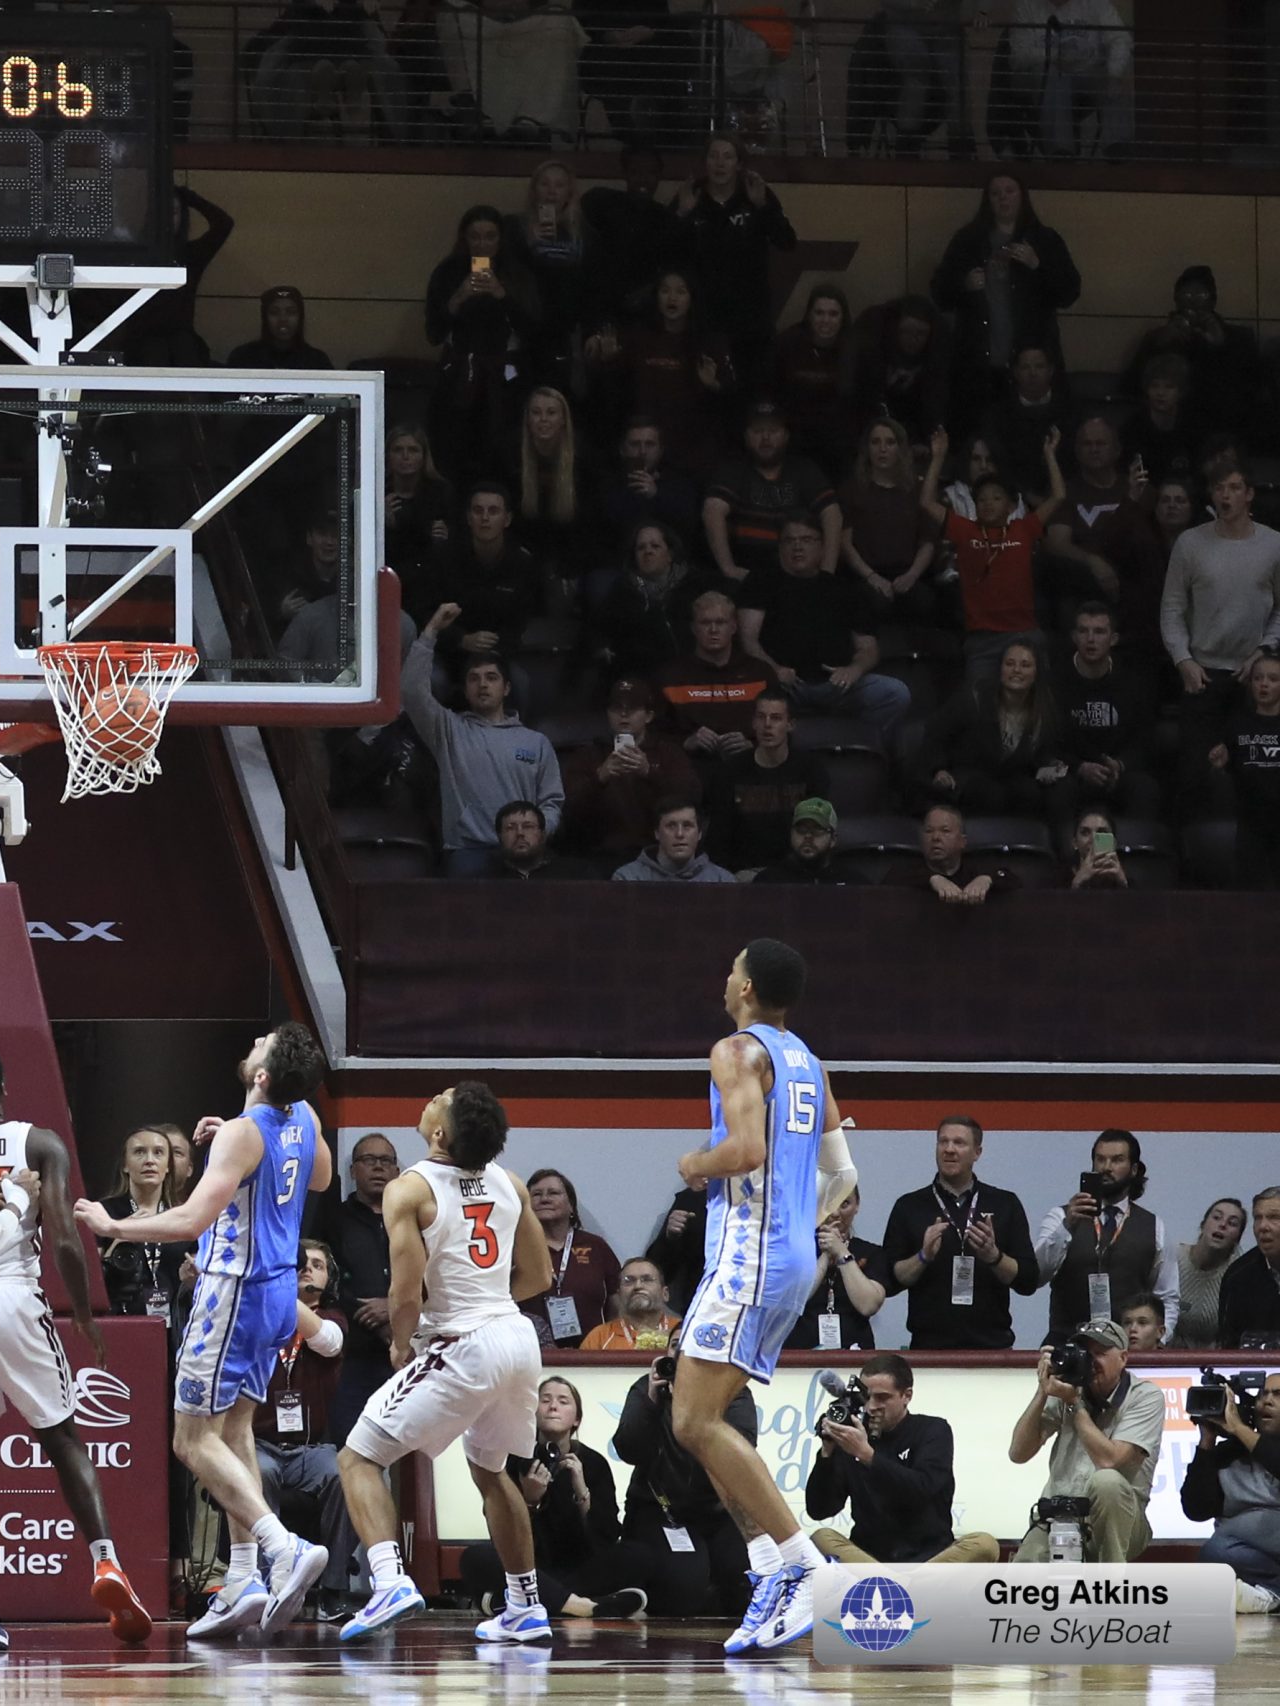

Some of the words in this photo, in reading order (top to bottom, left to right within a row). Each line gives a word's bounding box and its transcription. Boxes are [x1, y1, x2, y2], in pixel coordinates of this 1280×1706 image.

[25, 921, 124, 942] AX
[786, 1080, 817, 1134] 15
[277, 1157, 300, 1206] 3
[459, 1177, 488, 1198] BEDE
[462, 1202, 500, 1269] 3
[0, 1512, 75, 1541] Care
